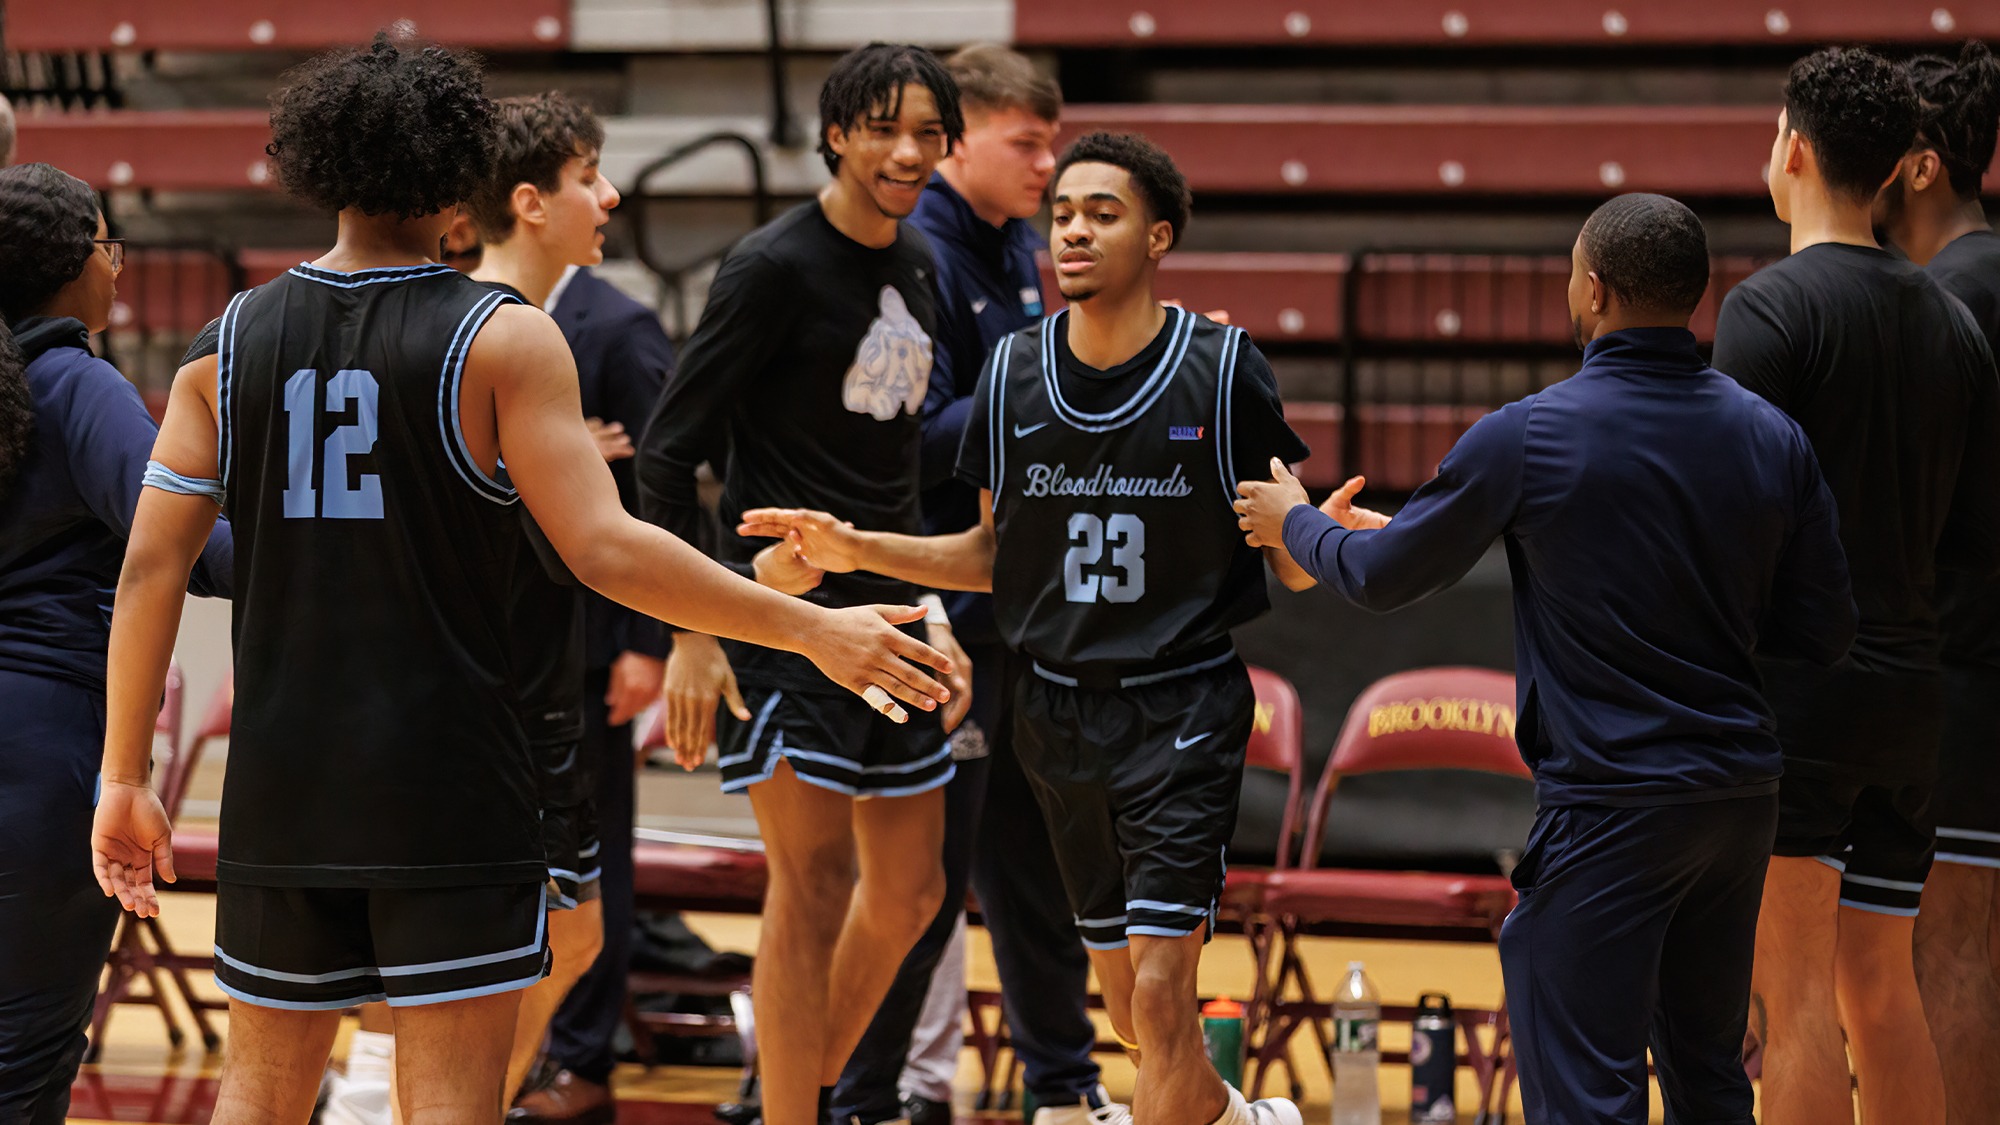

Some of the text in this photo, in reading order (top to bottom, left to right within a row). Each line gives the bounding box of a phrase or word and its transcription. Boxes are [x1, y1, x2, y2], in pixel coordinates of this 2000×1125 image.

[283, 369, 384, 519] 12
[1169, 426, 1204, 440] CUNY
[1022, 463, 1193, 497] Bloodhounds
[1064, 513, 1145, 603] 23
